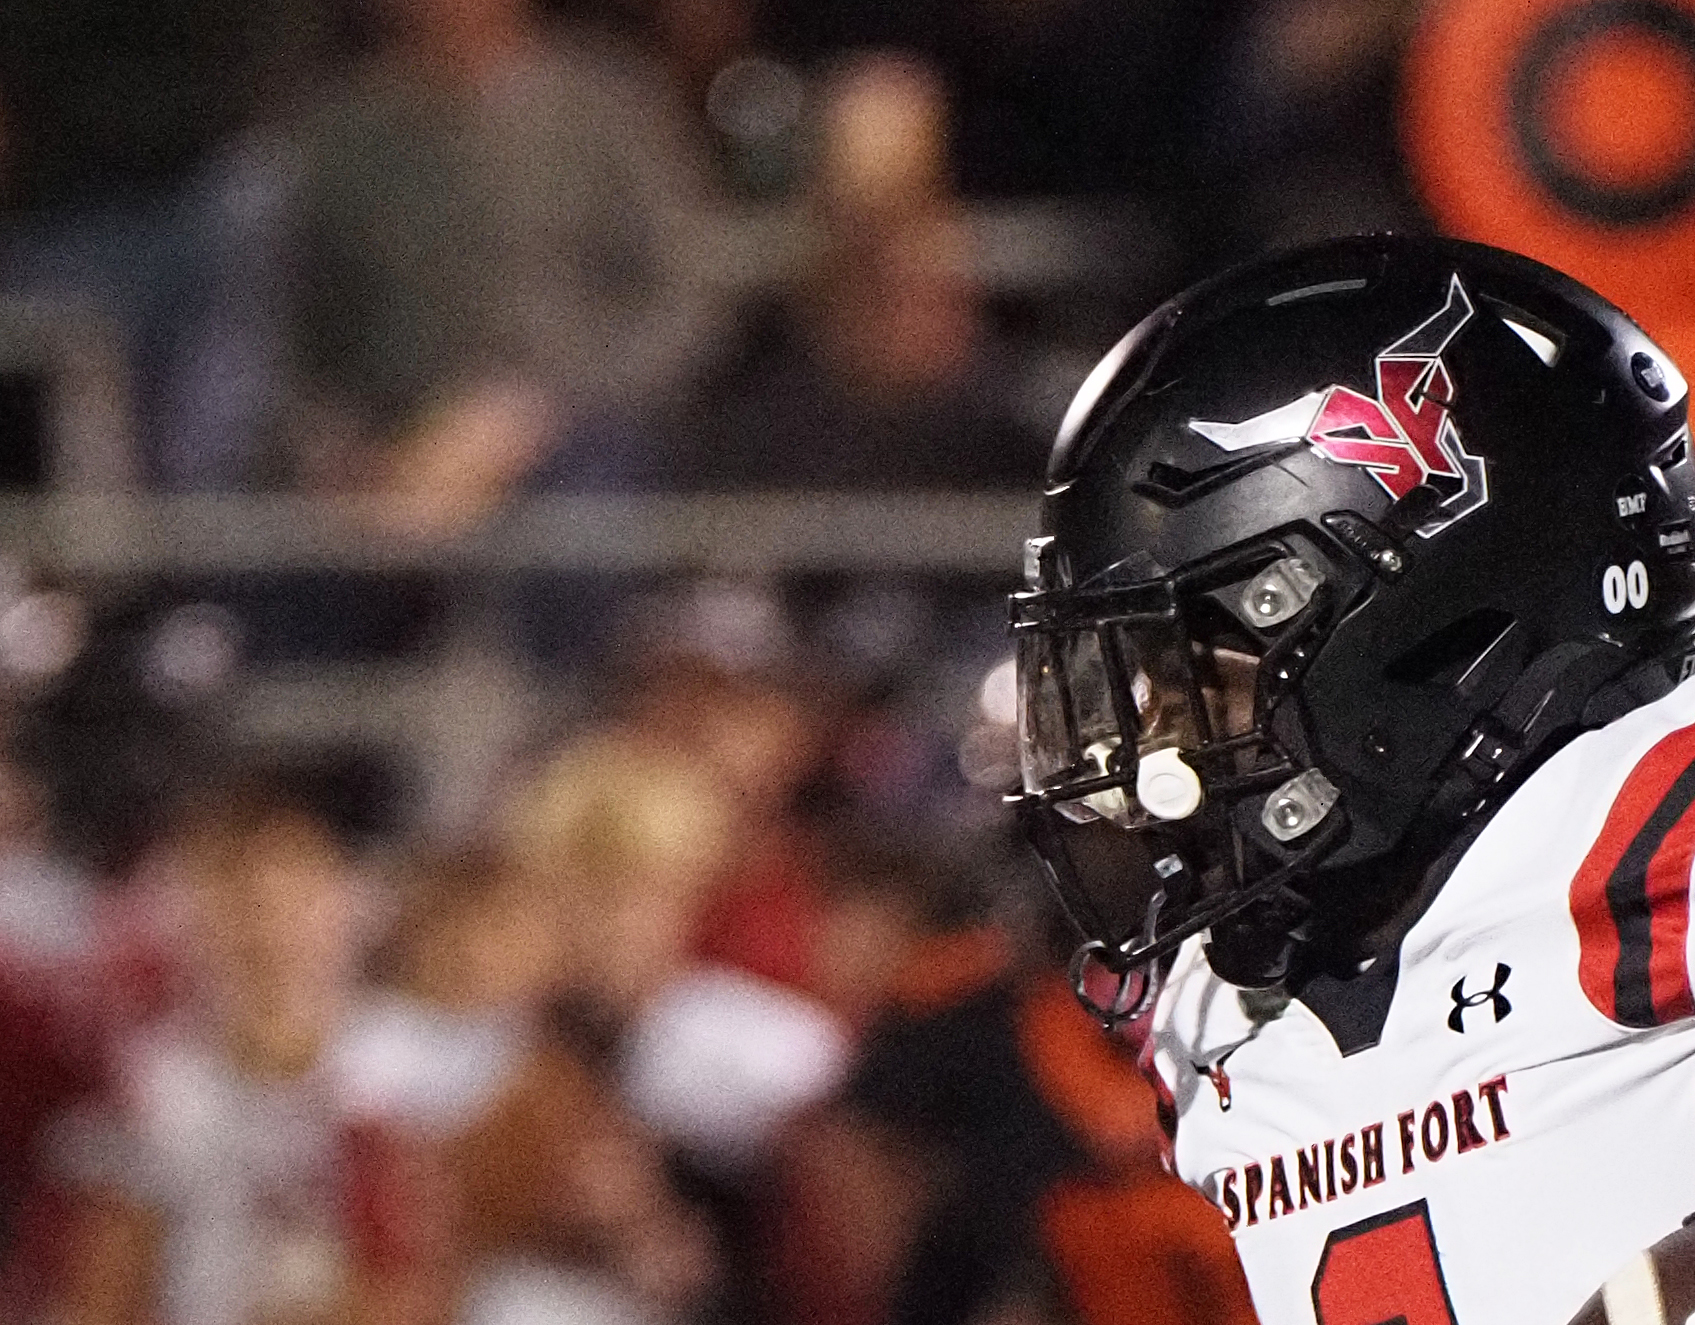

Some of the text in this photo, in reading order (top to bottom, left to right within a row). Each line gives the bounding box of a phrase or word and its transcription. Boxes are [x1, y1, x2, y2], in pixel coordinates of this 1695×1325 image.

[1603, 560, 1648, 614] 00
[1221, 1073, 1512, 1231] SPANISH FORT
